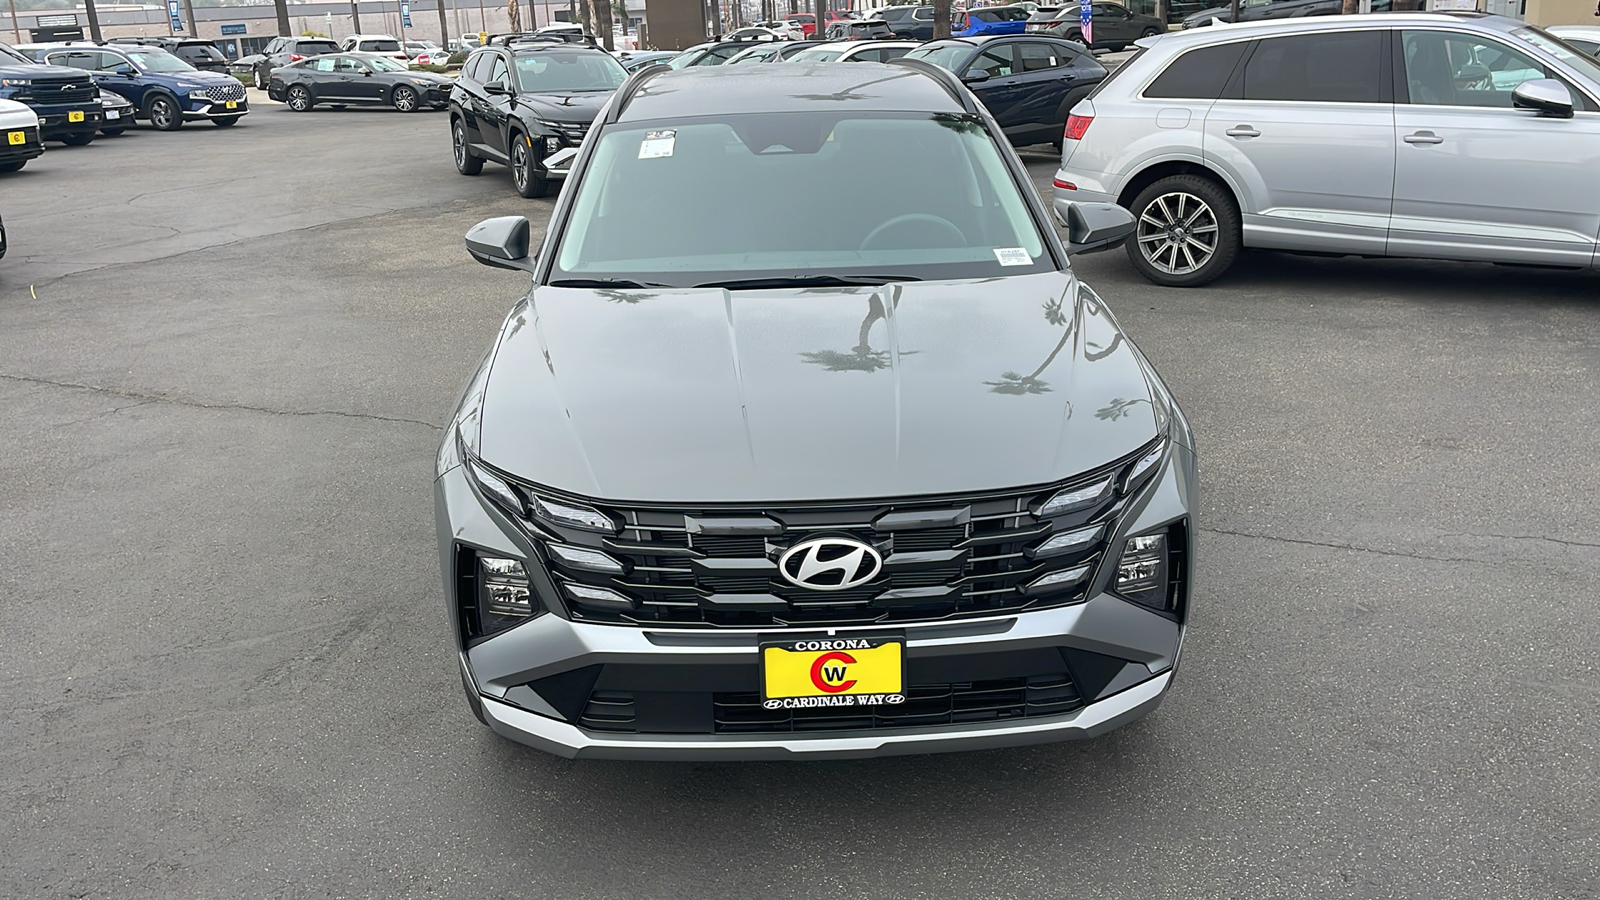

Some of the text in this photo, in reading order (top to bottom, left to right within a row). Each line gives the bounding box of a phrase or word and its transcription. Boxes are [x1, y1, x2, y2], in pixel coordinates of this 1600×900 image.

[795, 639, 871, 651] CORONA
[783, 694, 885, 709] CARDINALE WAY
